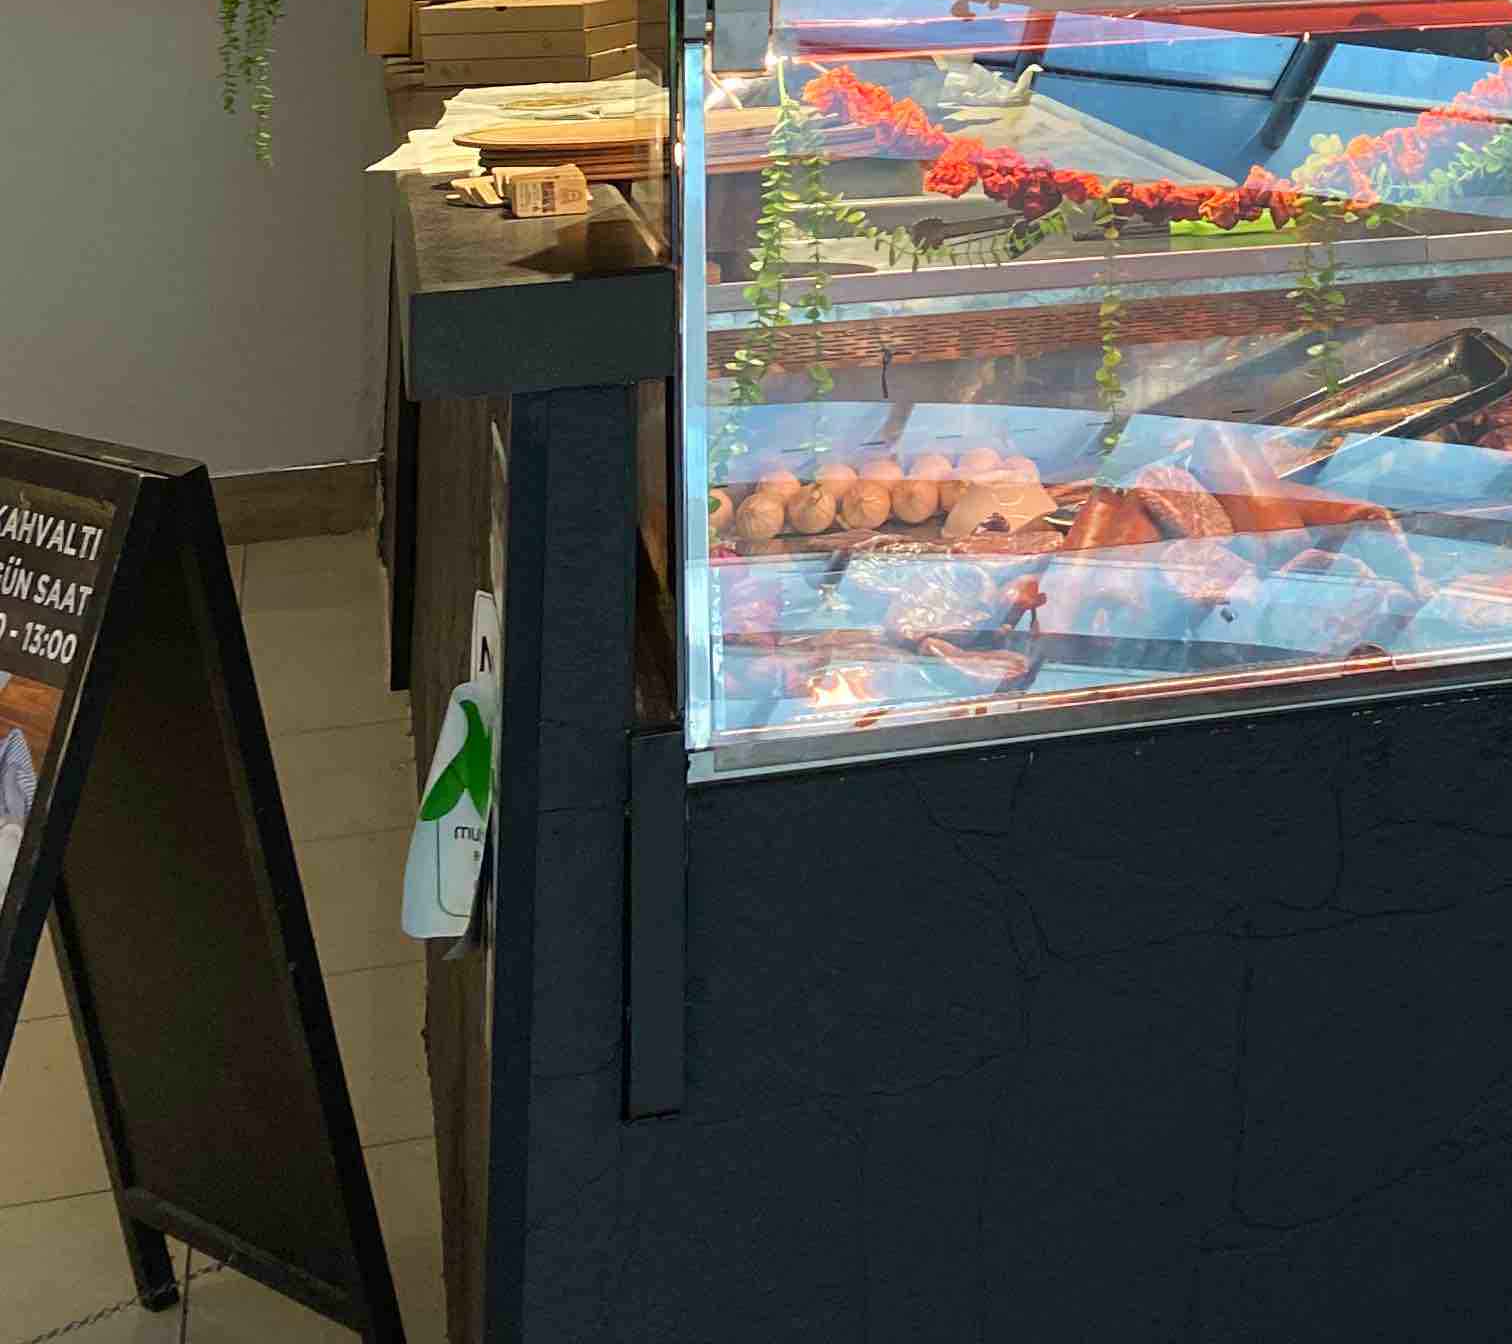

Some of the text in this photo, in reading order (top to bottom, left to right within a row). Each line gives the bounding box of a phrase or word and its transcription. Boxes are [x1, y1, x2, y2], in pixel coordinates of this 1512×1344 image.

[0, 555, 94, 617] ÜN SAAT
[22, 621, 77, 664] 13:00
